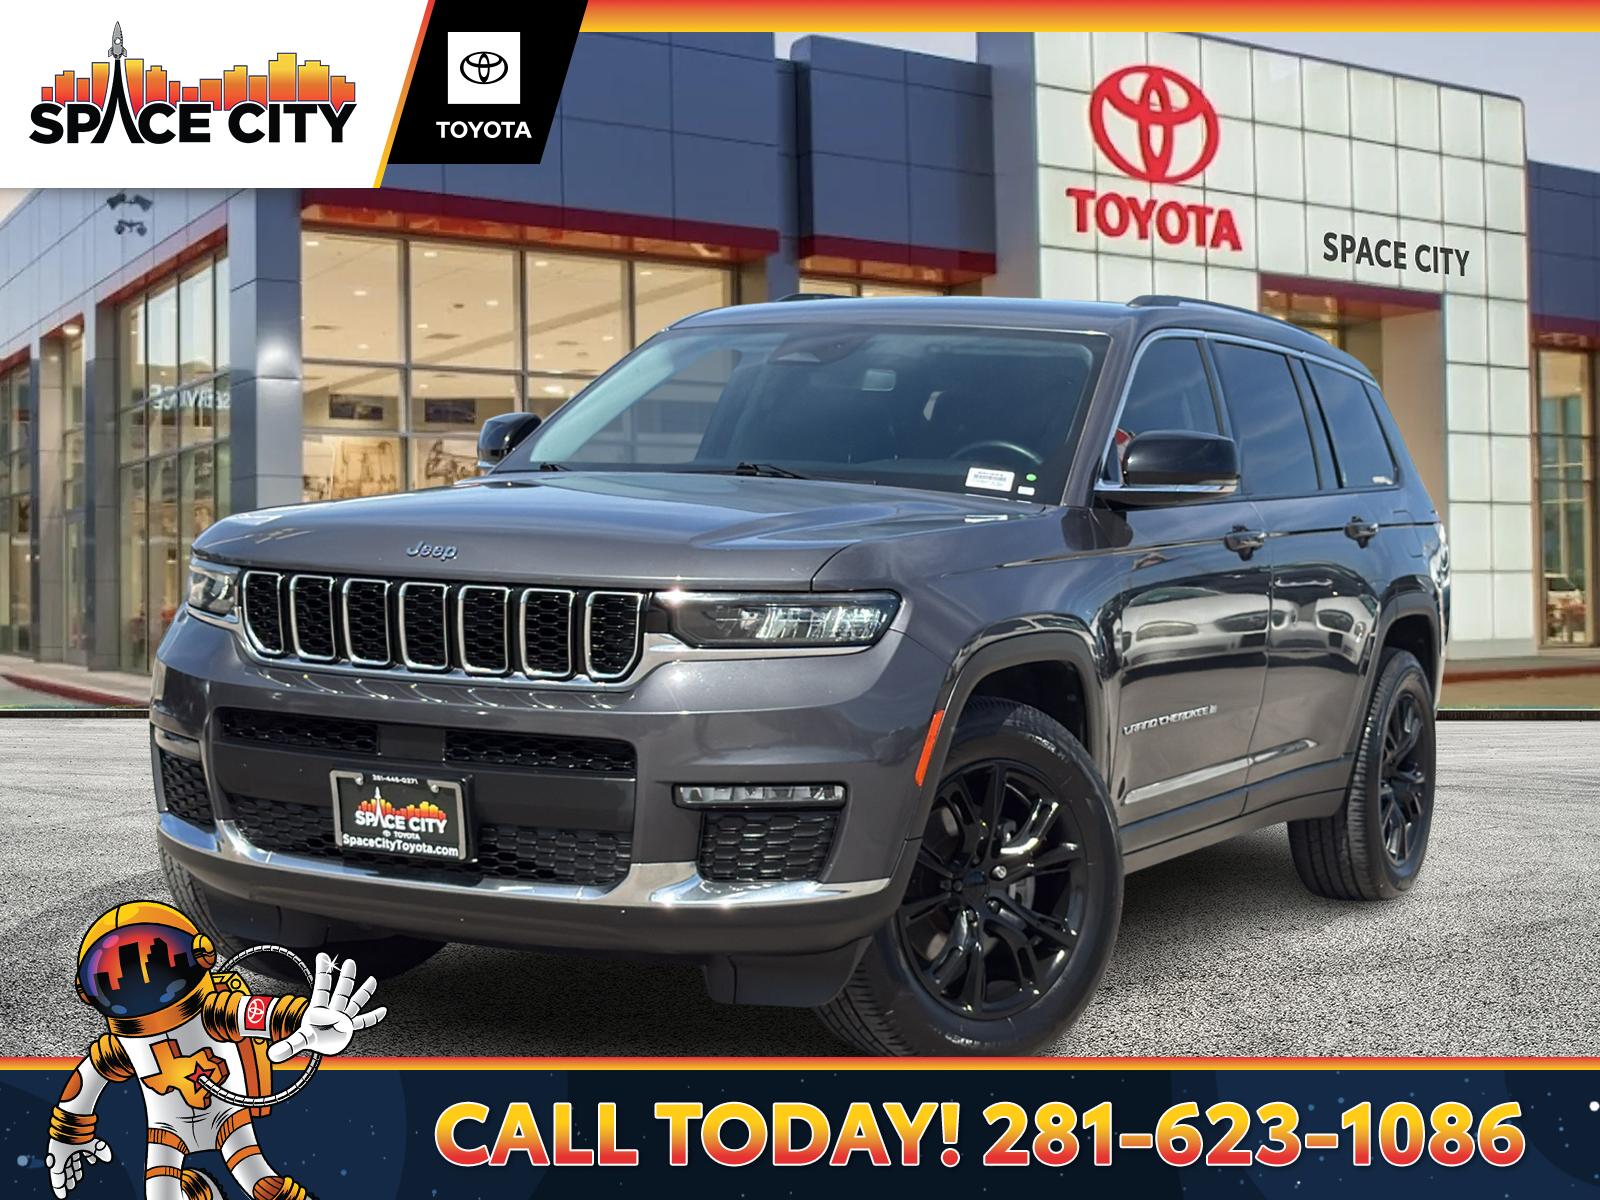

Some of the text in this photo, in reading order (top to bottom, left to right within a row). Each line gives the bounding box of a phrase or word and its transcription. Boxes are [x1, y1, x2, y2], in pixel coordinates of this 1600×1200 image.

[1066, 188, 1242, 251] TOYOTA
[1323, 231, 1470, 277] SPACE CITY
[406, 540, 457, 561] Jeep
[355, 801, 447, 834] SPACE CITY
[342, 833, 459, 857] SpaceCityToyota.com
[394, 831, 421, 841] TOYOTA
